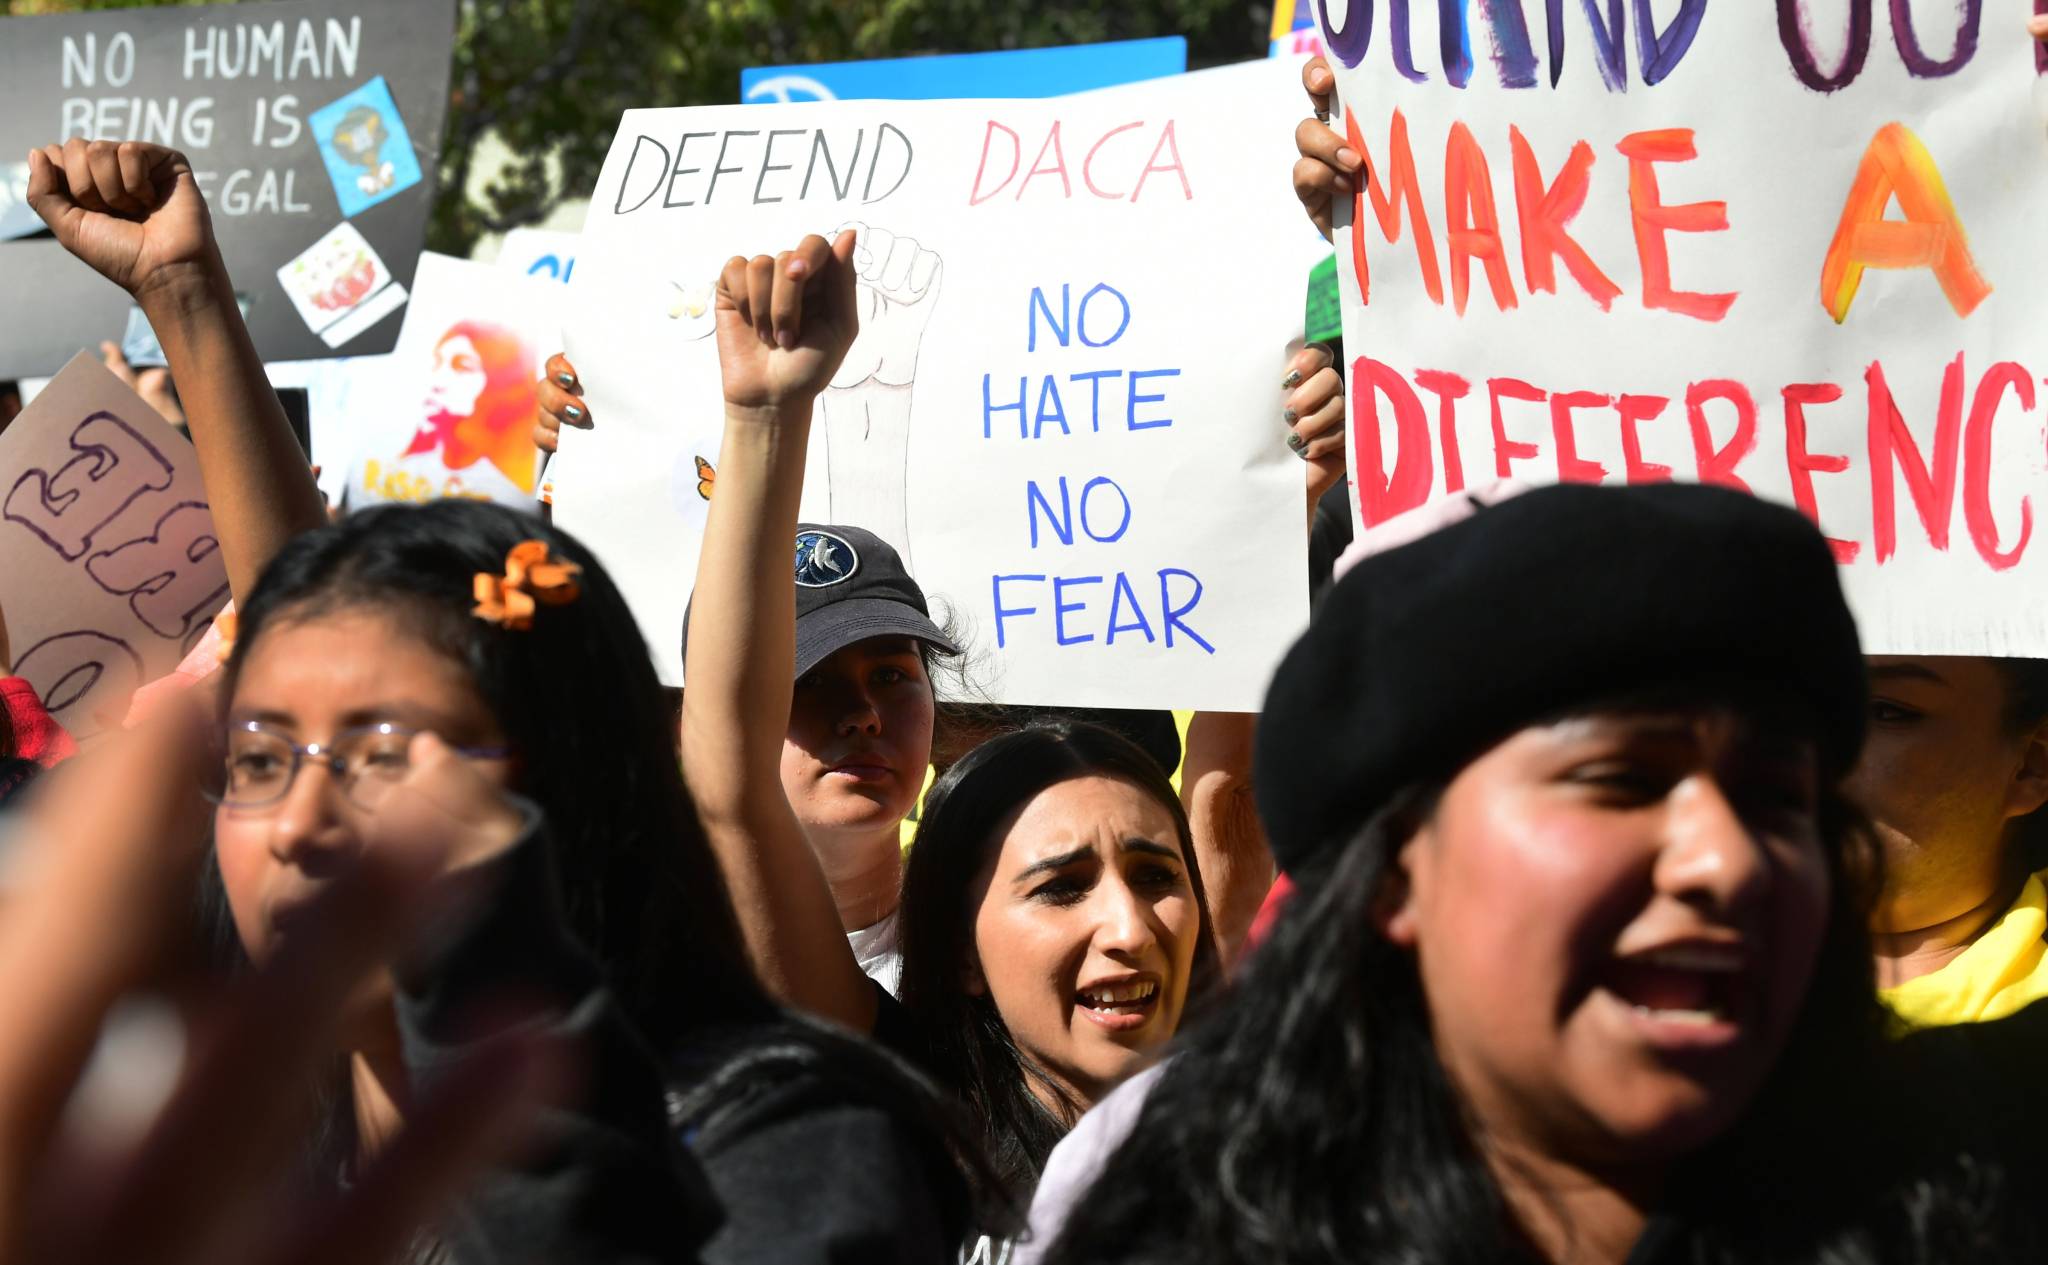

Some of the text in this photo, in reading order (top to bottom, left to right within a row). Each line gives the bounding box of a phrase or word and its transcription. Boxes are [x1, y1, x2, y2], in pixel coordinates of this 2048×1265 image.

[61, 16, 361, 89] NO HUMAN
[61, 95, 301, 147] BEING IS
[614, 119, 1193, 215] DEFEND DACA
[1345, 105, 1994, 324] MAKE A
[1027, 282, 1131, 352] NO
[983, 368, 1181, 439] HATE
[1348, 350, 2048, 572] DIFFERENC
[1027, 475, 1132, 549] NO
[992, 567, 1215, 655] FEAR
